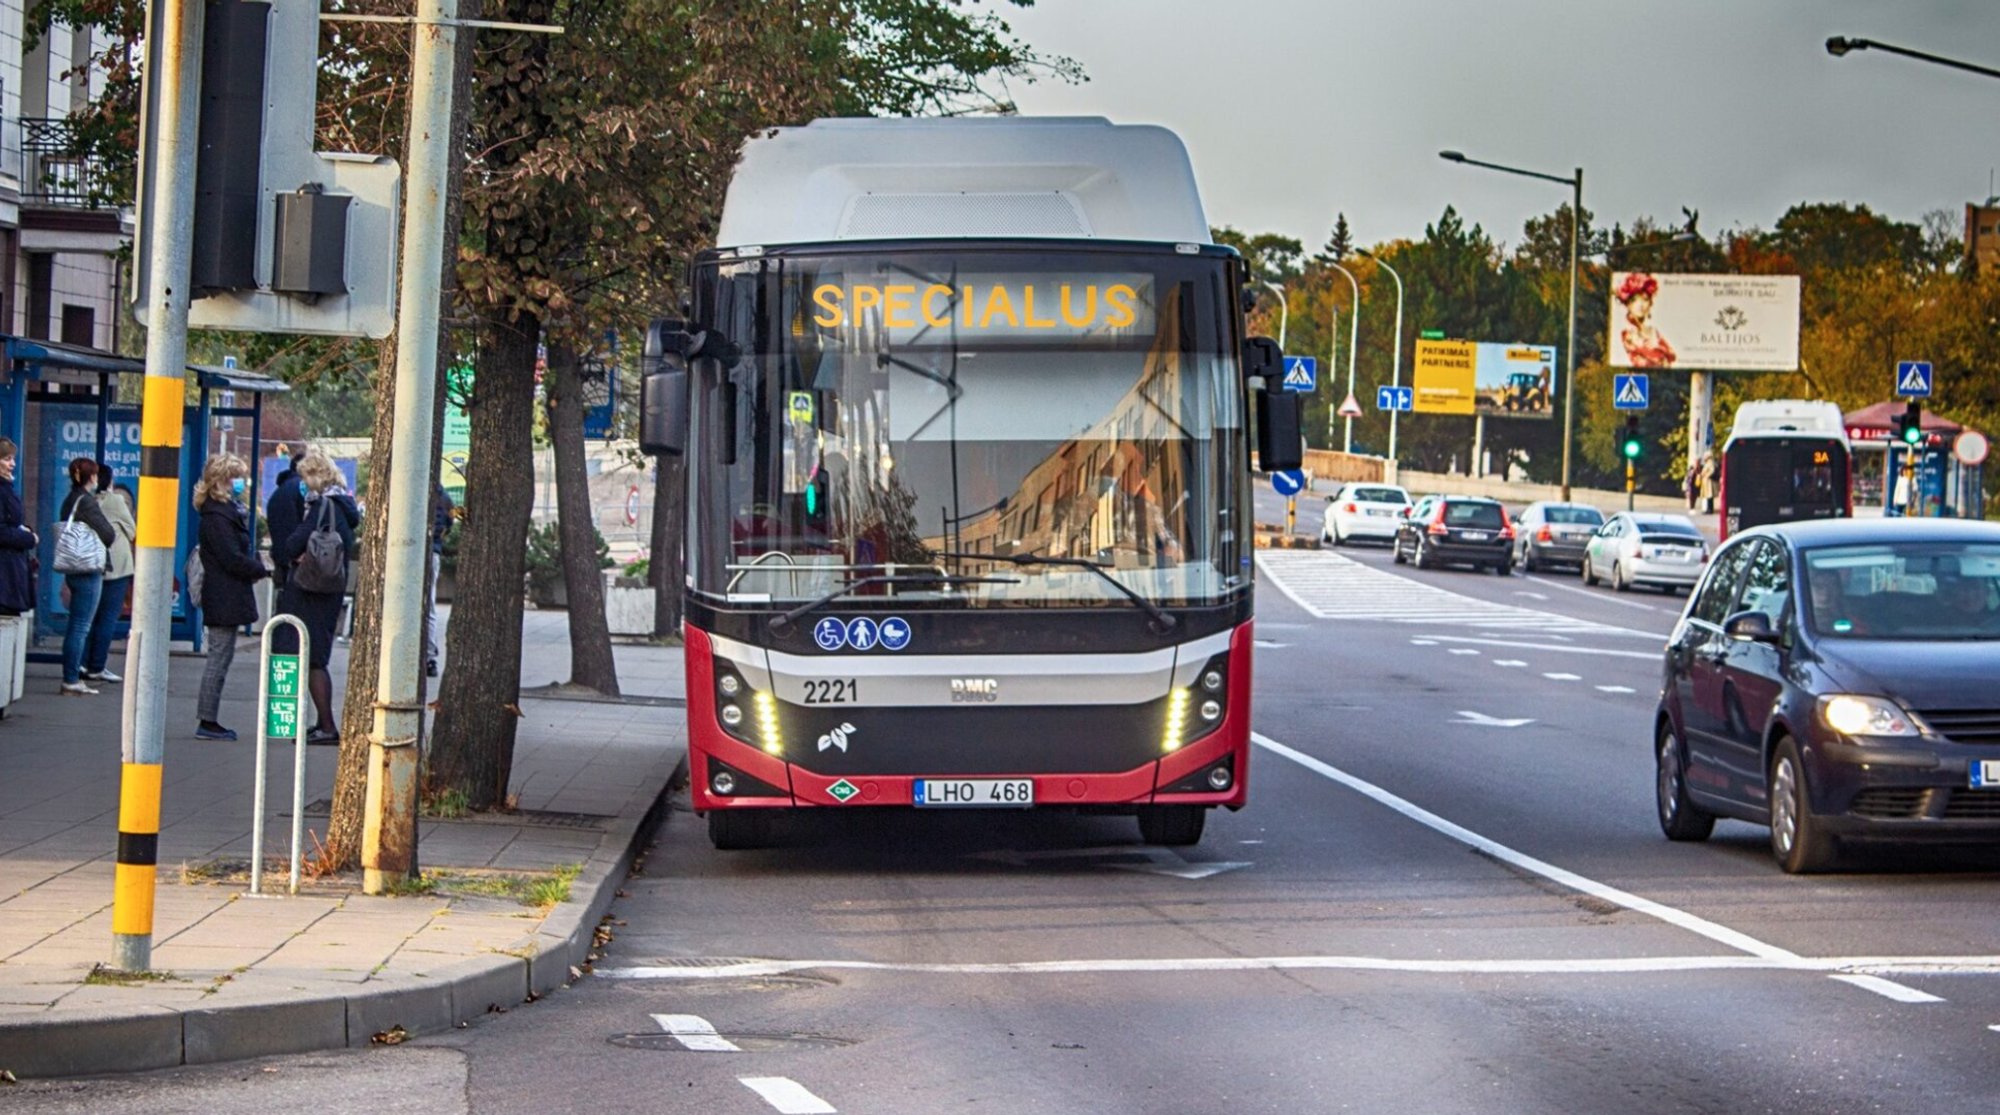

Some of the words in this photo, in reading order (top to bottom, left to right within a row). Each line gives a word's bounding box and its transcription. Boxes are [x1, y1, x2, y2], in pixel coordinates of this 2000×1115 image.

[813, 284, 1137, 328] SPECIALUS
[1701, 332, 1761, 346] BALTIJOS
[1422, 346, 1470, 357] PATIKIMAS
[1814, 451, 1829, 464] 3A
[803, 678, 858, 704] 2221
[951, 679, 998, 702] BMC
[834, 786, 850, 795] CNG
[927, 783, 975, 803] LHO
[990, 782, 1029, 803] 468
